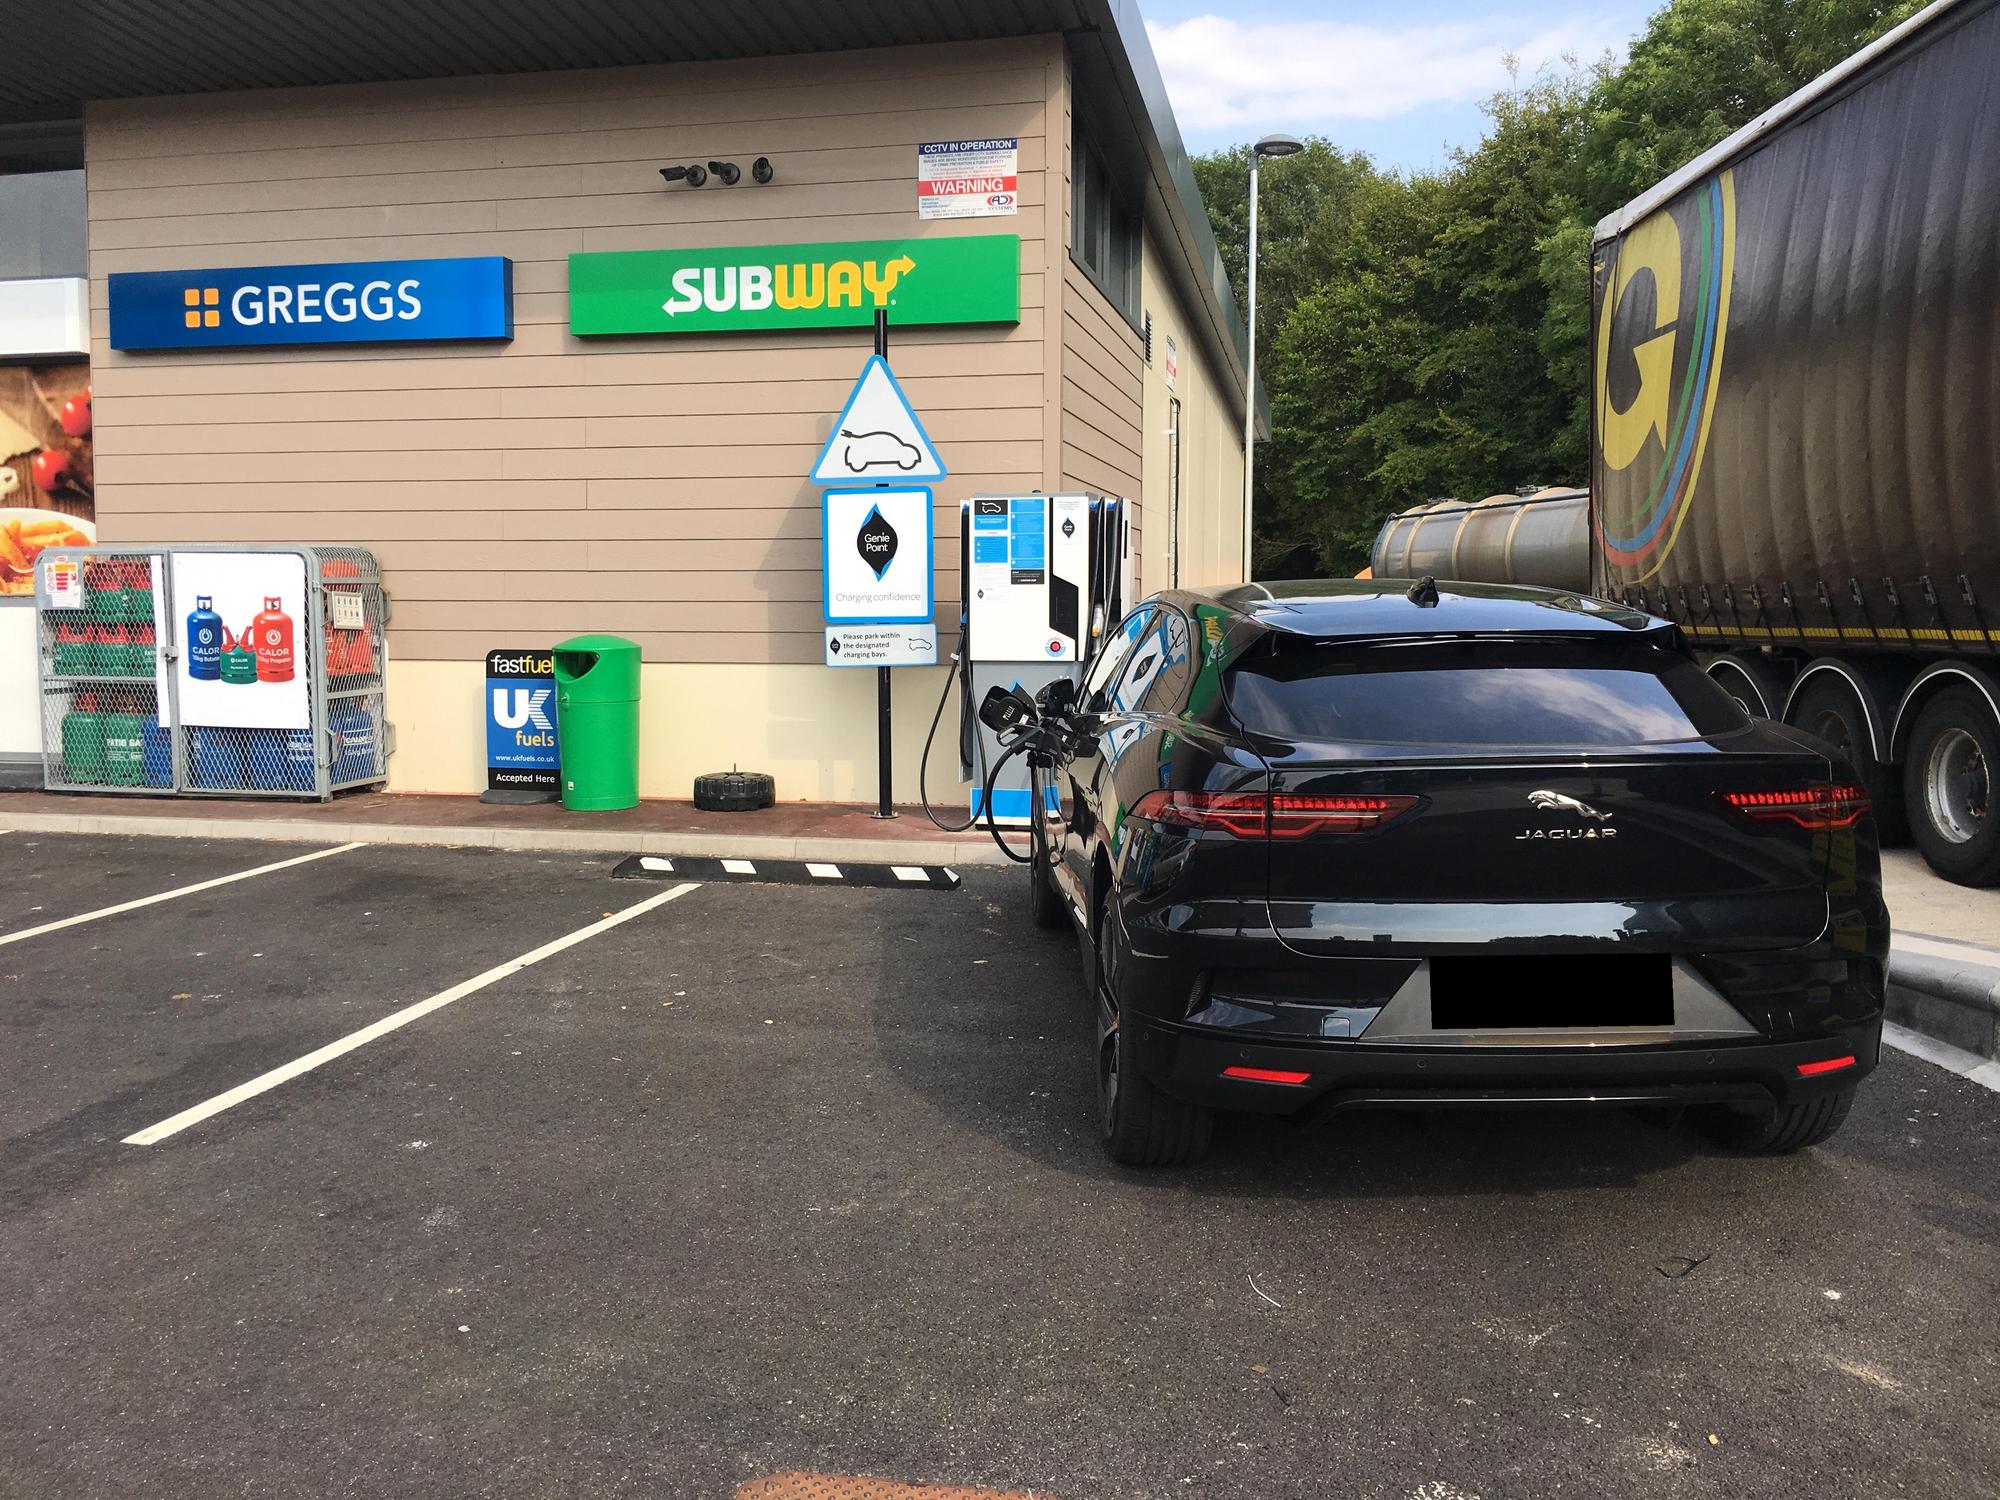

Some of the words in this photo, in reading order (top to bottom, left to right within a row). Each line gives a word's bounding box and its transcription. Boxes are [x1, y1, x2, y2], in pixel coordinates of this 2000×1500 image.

[924, 144, 948, 153] CCTV
[949, 143, 959, 151] IN
[960, 140, 1012, 151] OPERATION
[931, 178, 1003, 194] WARNING
[661, 255, 916, 317] SUBWAY
[231, 279, 421, 326] GREGGS
[864, 532, 890, 543] Genie
[866, 543, 889, 552] Point
[836, 593, 872, 603] Charging
[873, 593, 921, 601] confidence
[864, 633, 878, 641] park
[192, 646, 220, 655] CALOR
[855, 642, 890, 650] designated
[259, 648, 289, 656] CALOR
[871, 651, 887, 659] bays.
[490, 655, 554, 674] fastfuel
[493, 688, 554, 730] UK
[515, 731, 555, 747] fuels
[495, 755, 555, 763] www.ukfuels.co.uk
[496, 773, 533, 783] Accepted
[535, 774, 555, 783] Here
[1515, 828, 1617, 840] JAGUAR
